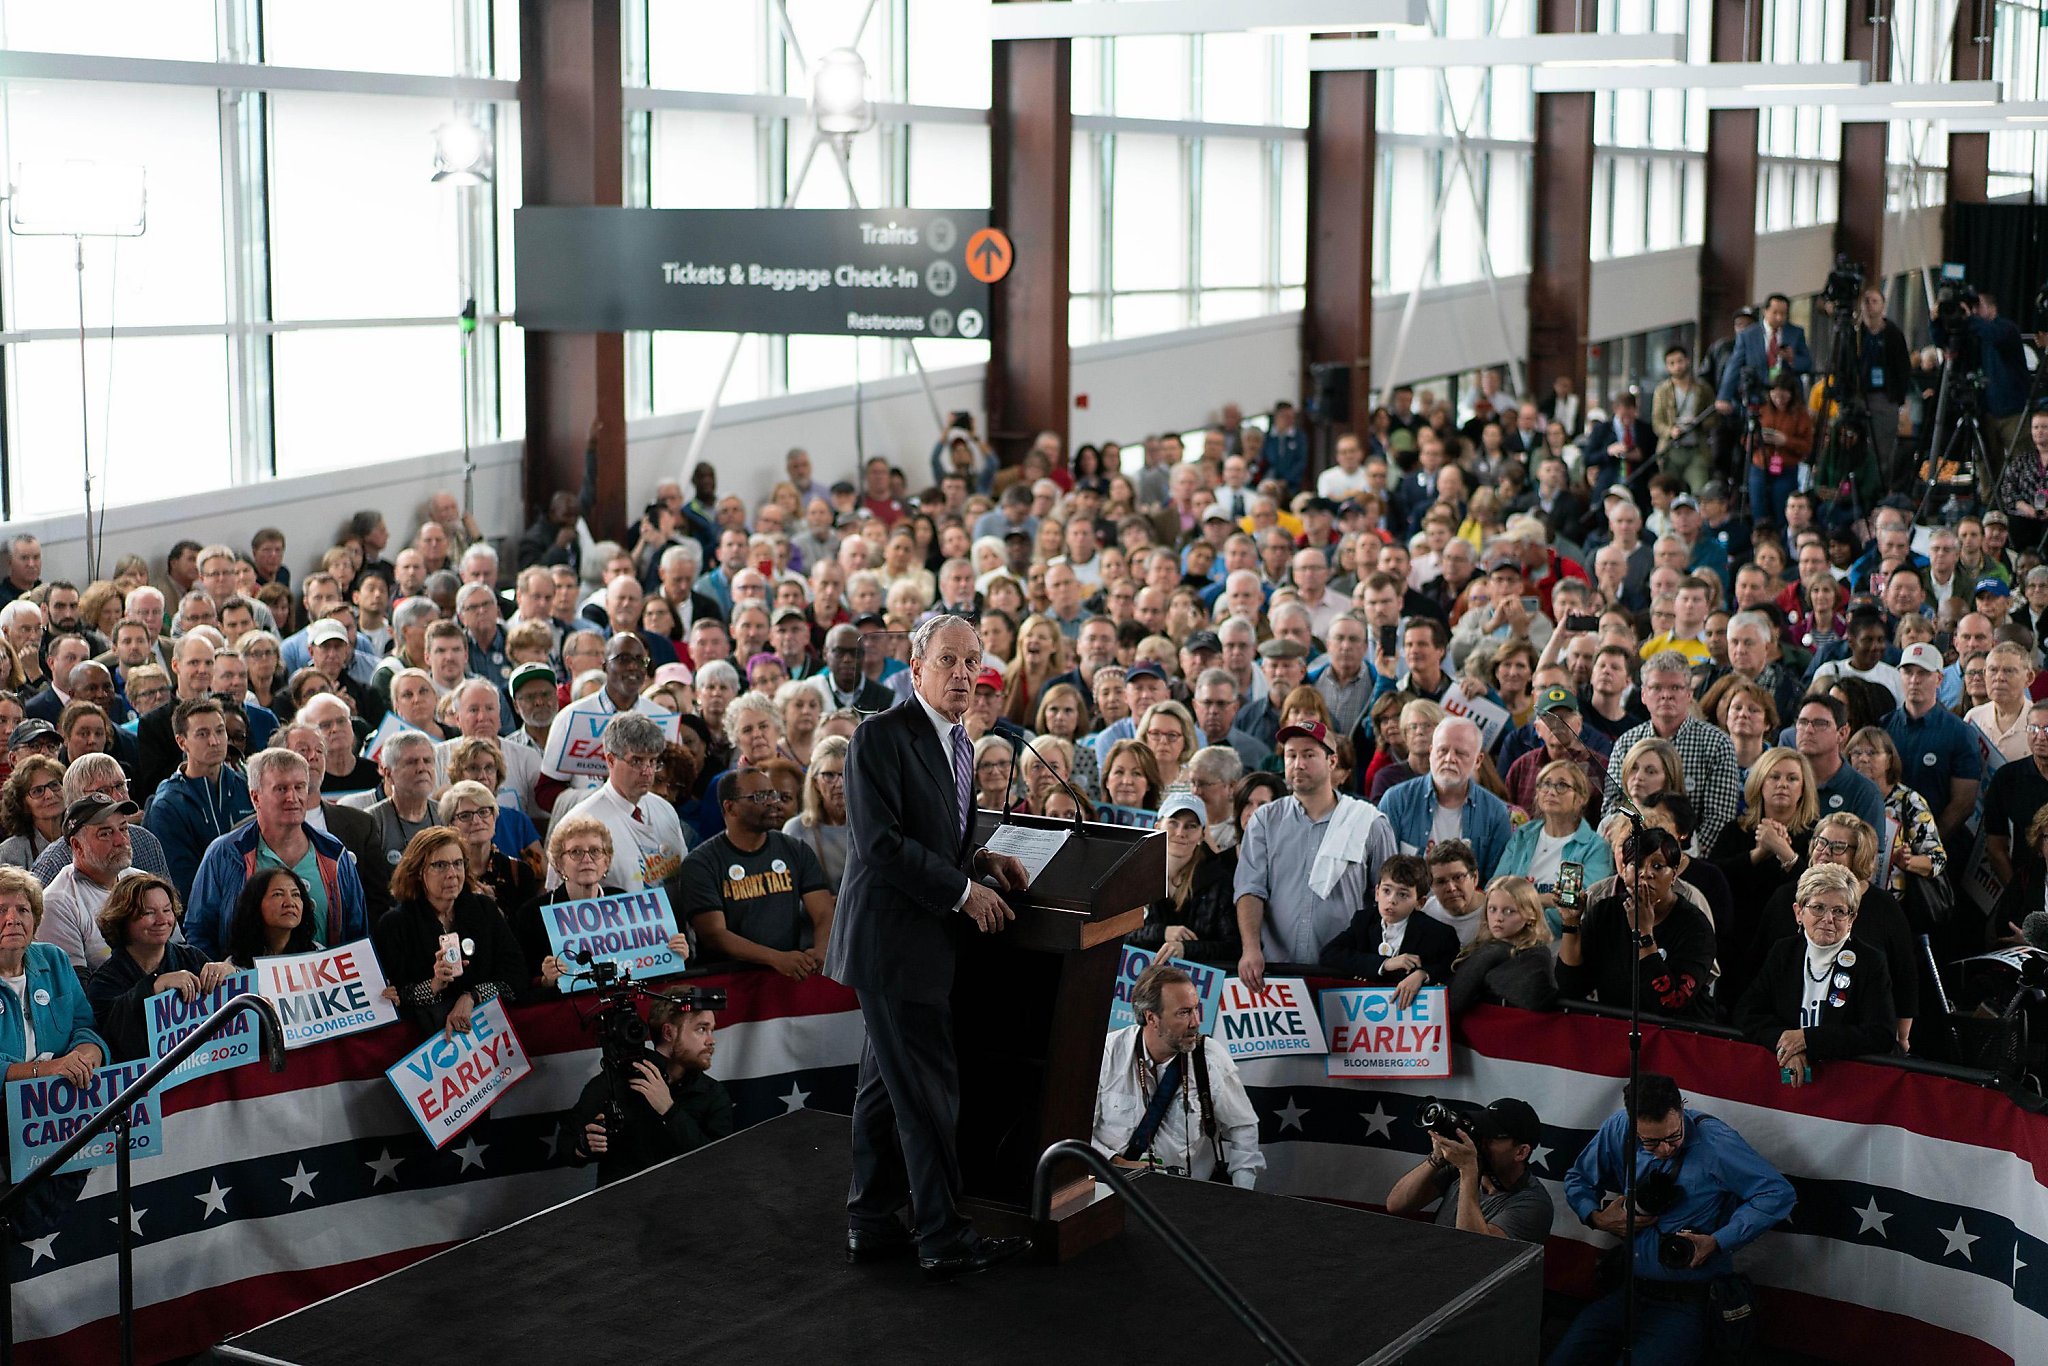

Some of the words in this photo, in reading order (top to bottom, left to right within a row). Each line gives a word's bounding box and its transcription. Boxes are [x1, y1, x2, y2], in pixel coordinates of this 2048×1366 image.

[860, 223, 918, 245] Trains
[662, 262, 725, 285] Tickets
[729, 264, 744, 285] &
[748, 264, 831, 291] Baggage
[835, 265, 918, 288] Check-In
[847, 312, 924, 331] Restrooms
[730, 872, 766, 900] BRONX
[763, 869, 793, 894] TALE
[553, 892, 663, 936] NORTH
[563, 924, 669, 961] CAROLINA
[272, 965, 283, 993] I
[284, 952, 361, 993] LIKE
[635, 952, 673, 969] 2020
[278, 981, 371, 1026] MIKE
[1231, 984, 1298, 1010] LIKE
[1340, 994, 1430, 1022] VOTE
[286, 1010, 376, 1041] BLOOMBERG
[1222, 1011, 1307, 1040] MIKE
[1331, 1025, 1442, 1053] EARLY!
[211, 1043, 249, 1063] 2020
[1229, 1038, 1310, 1054] BLOOMBERG
[417, 1031, 514, 1122] EARLY!
[1344, 1058, 1430, 1068] BLOOMBERG2020
[20, 1063, 149, 1120] NORTH
[105, 1135, 150, 1155] 220
